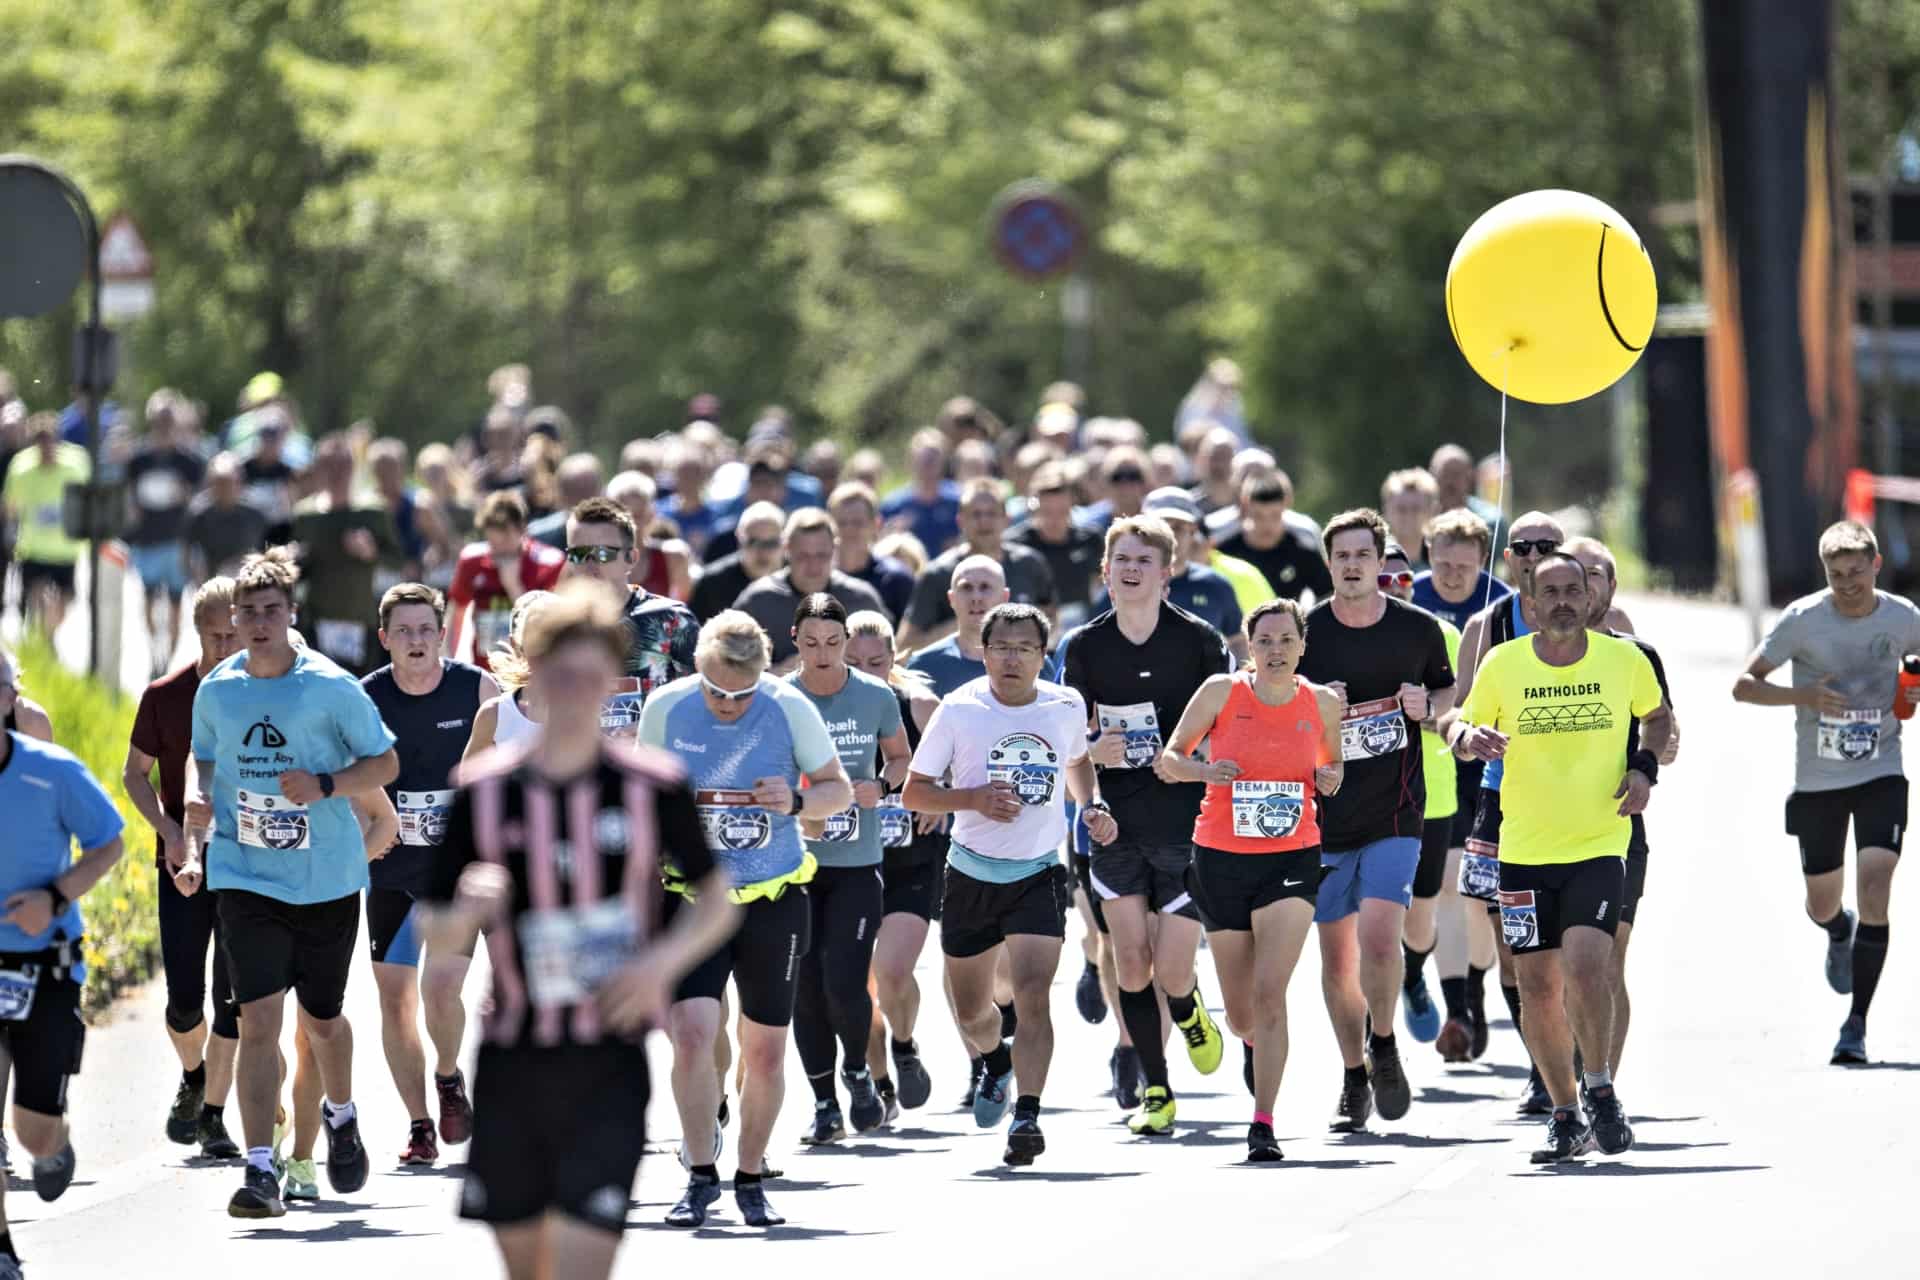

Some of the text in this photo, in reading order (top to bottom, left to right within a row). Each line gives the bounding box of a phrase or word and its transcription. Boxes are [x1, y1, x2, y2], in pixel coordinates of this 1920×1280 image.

[1524, 682, 1601, 699] FARTHOLDER
[825, 718, 858, 733] bælt
[834, 733, 874, 745] rathon
[1235, 782, 1300, 793] REMA 1000
[1271, 818, 1287, 826] 799
